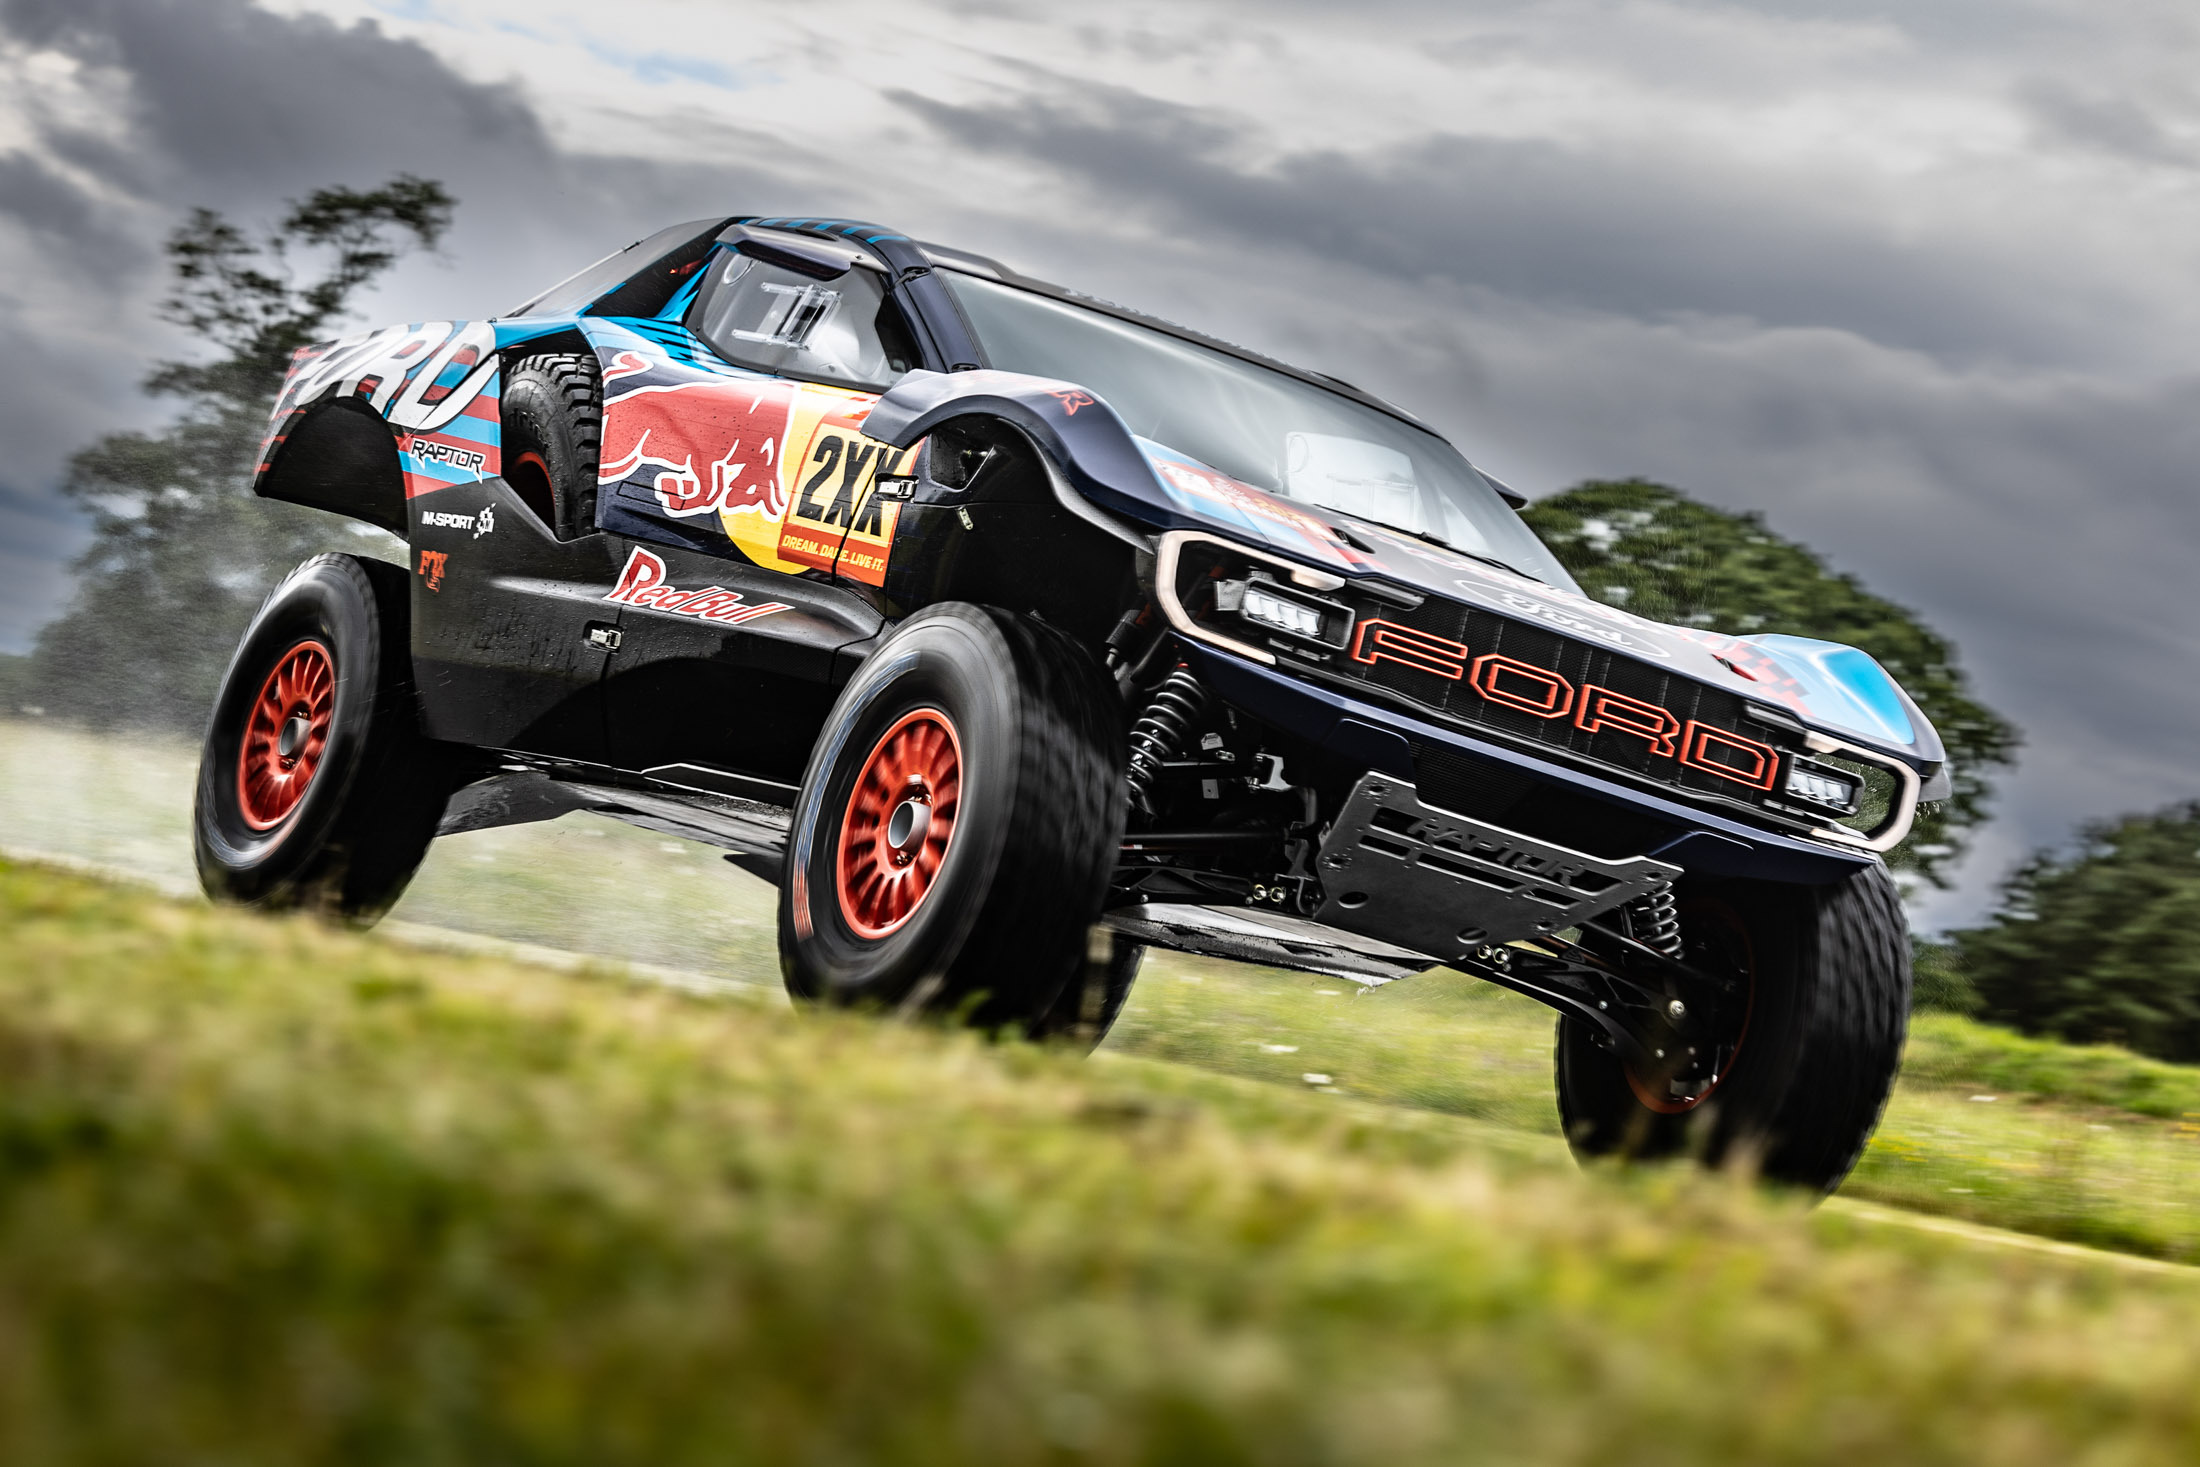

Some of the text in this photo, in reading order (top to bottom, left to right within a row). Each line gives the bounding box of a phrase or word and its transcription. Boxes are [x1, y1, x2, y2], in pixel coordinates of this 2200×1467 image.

[409, 439, 485, 480] RAPTOR
[796, 435, 906, 537] 2XX
[421, 511, 475, 529] M-SPORT
[418, 550, 448, 592] FOX
[781, 534, 819, 555] DREAM.
[850, 552, 873, 569] LIVE
[871, 557, 885, 572] IT.
[1500, 592, 1632, 645] Ford
[1351, 618, 1780, 792] FORD
[1407, 818, 1587, 889] RAPTOR
